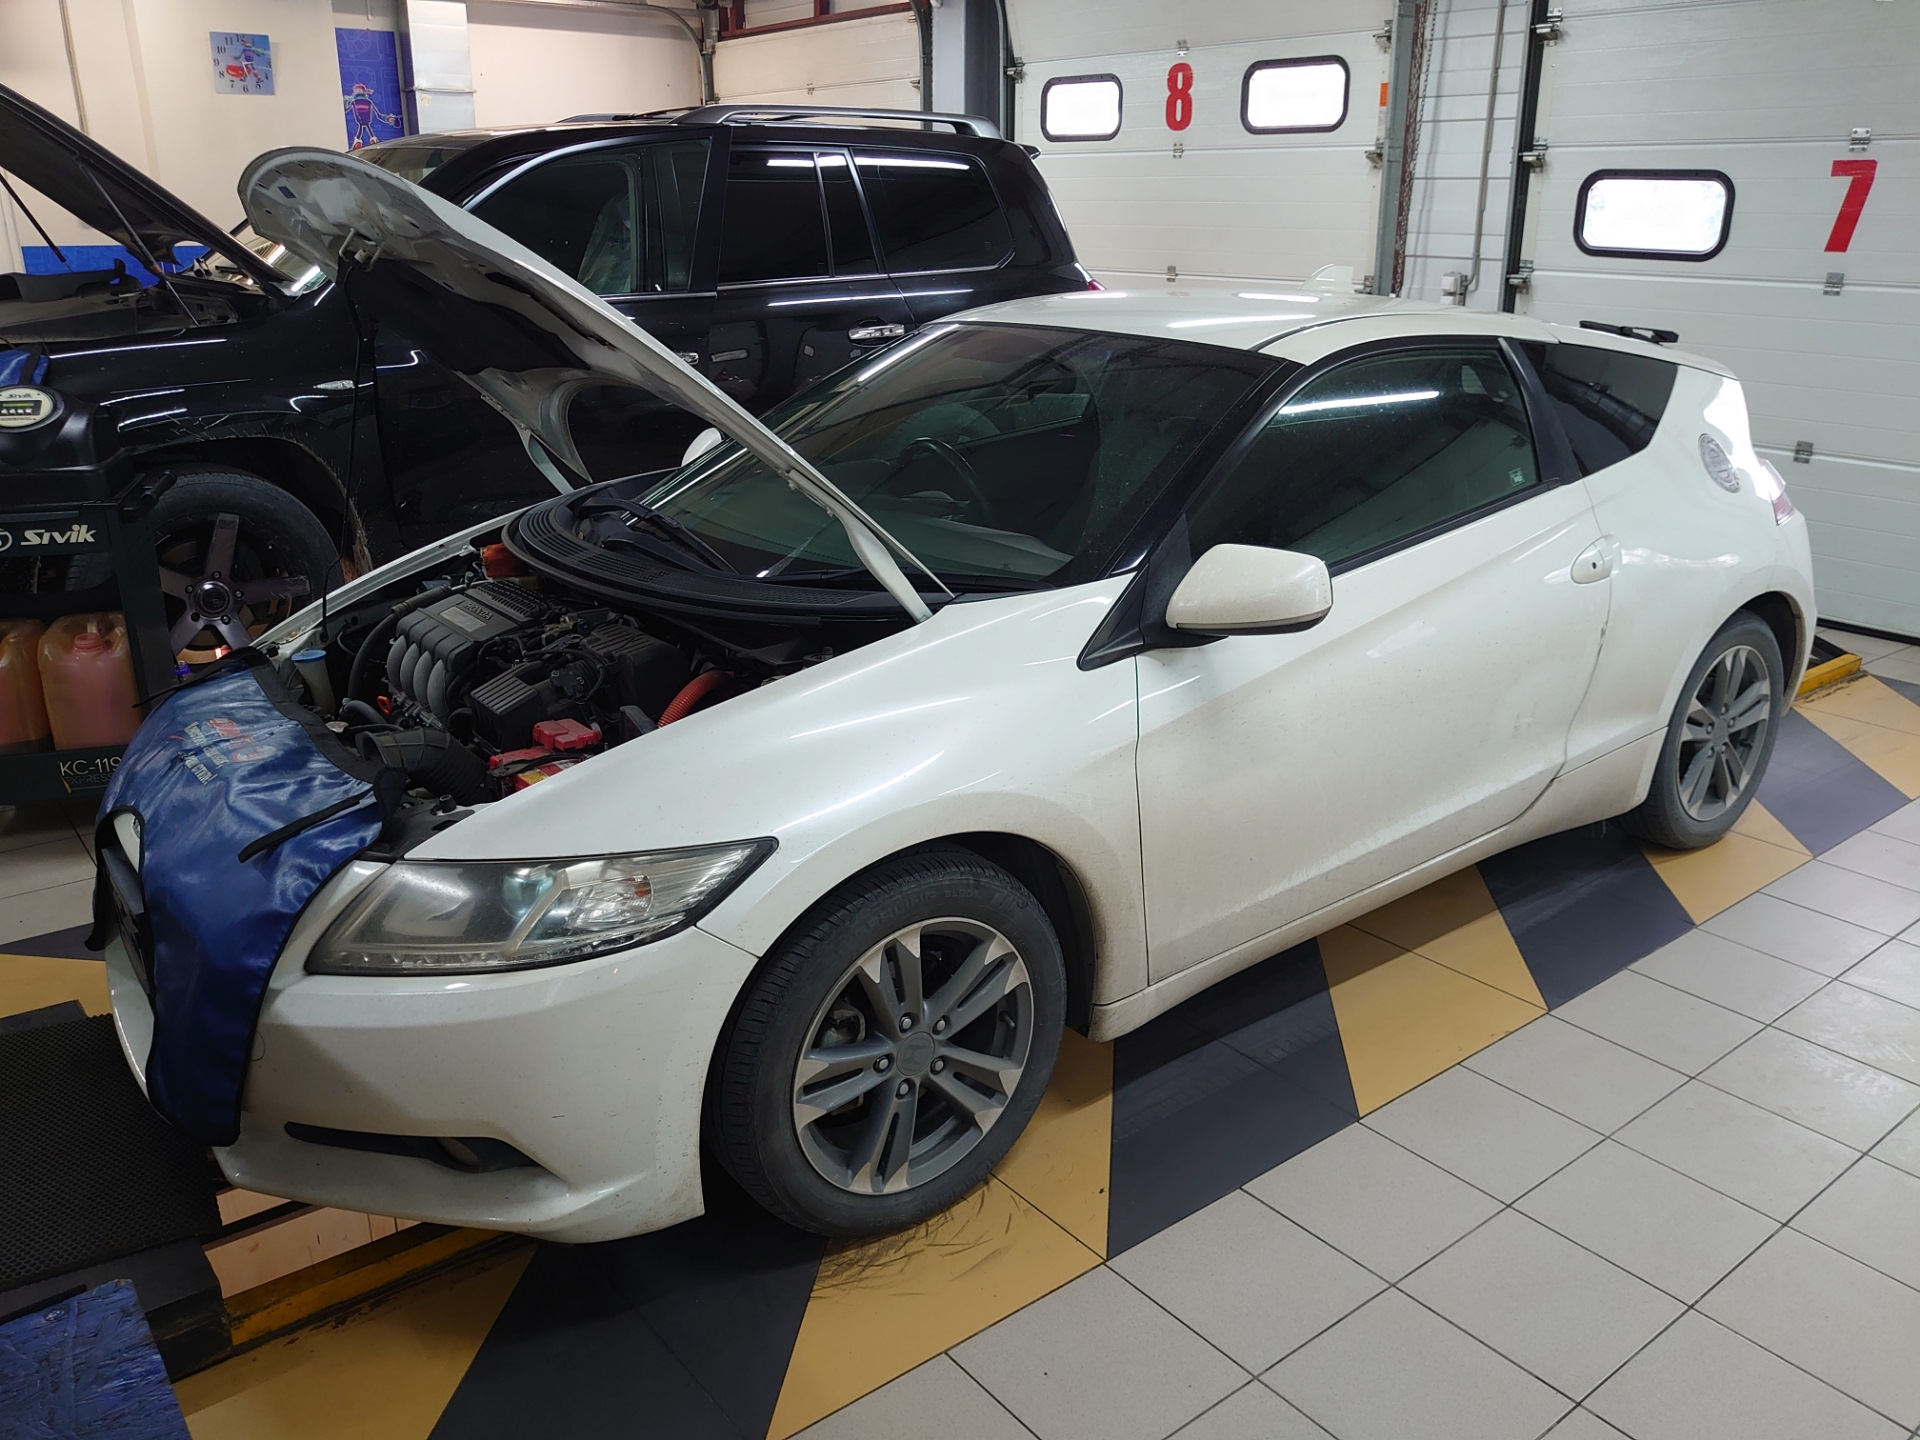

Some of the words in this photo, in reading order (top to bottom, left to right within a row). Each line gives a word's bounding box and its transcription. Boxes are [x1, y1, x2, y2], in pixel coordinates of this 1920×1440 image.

[225, 37, 234, 45] 11
[217, 46, 226, 54] 10
[213, 58, 219, 66] 9
[219, 71, 225, 79] 8
[230, 79, 235, 88] 7
[1165, 62, 1193, 132] 8
[1824, 159, 1878, 253] 7
[464, 602, 494, 620] HONDA
